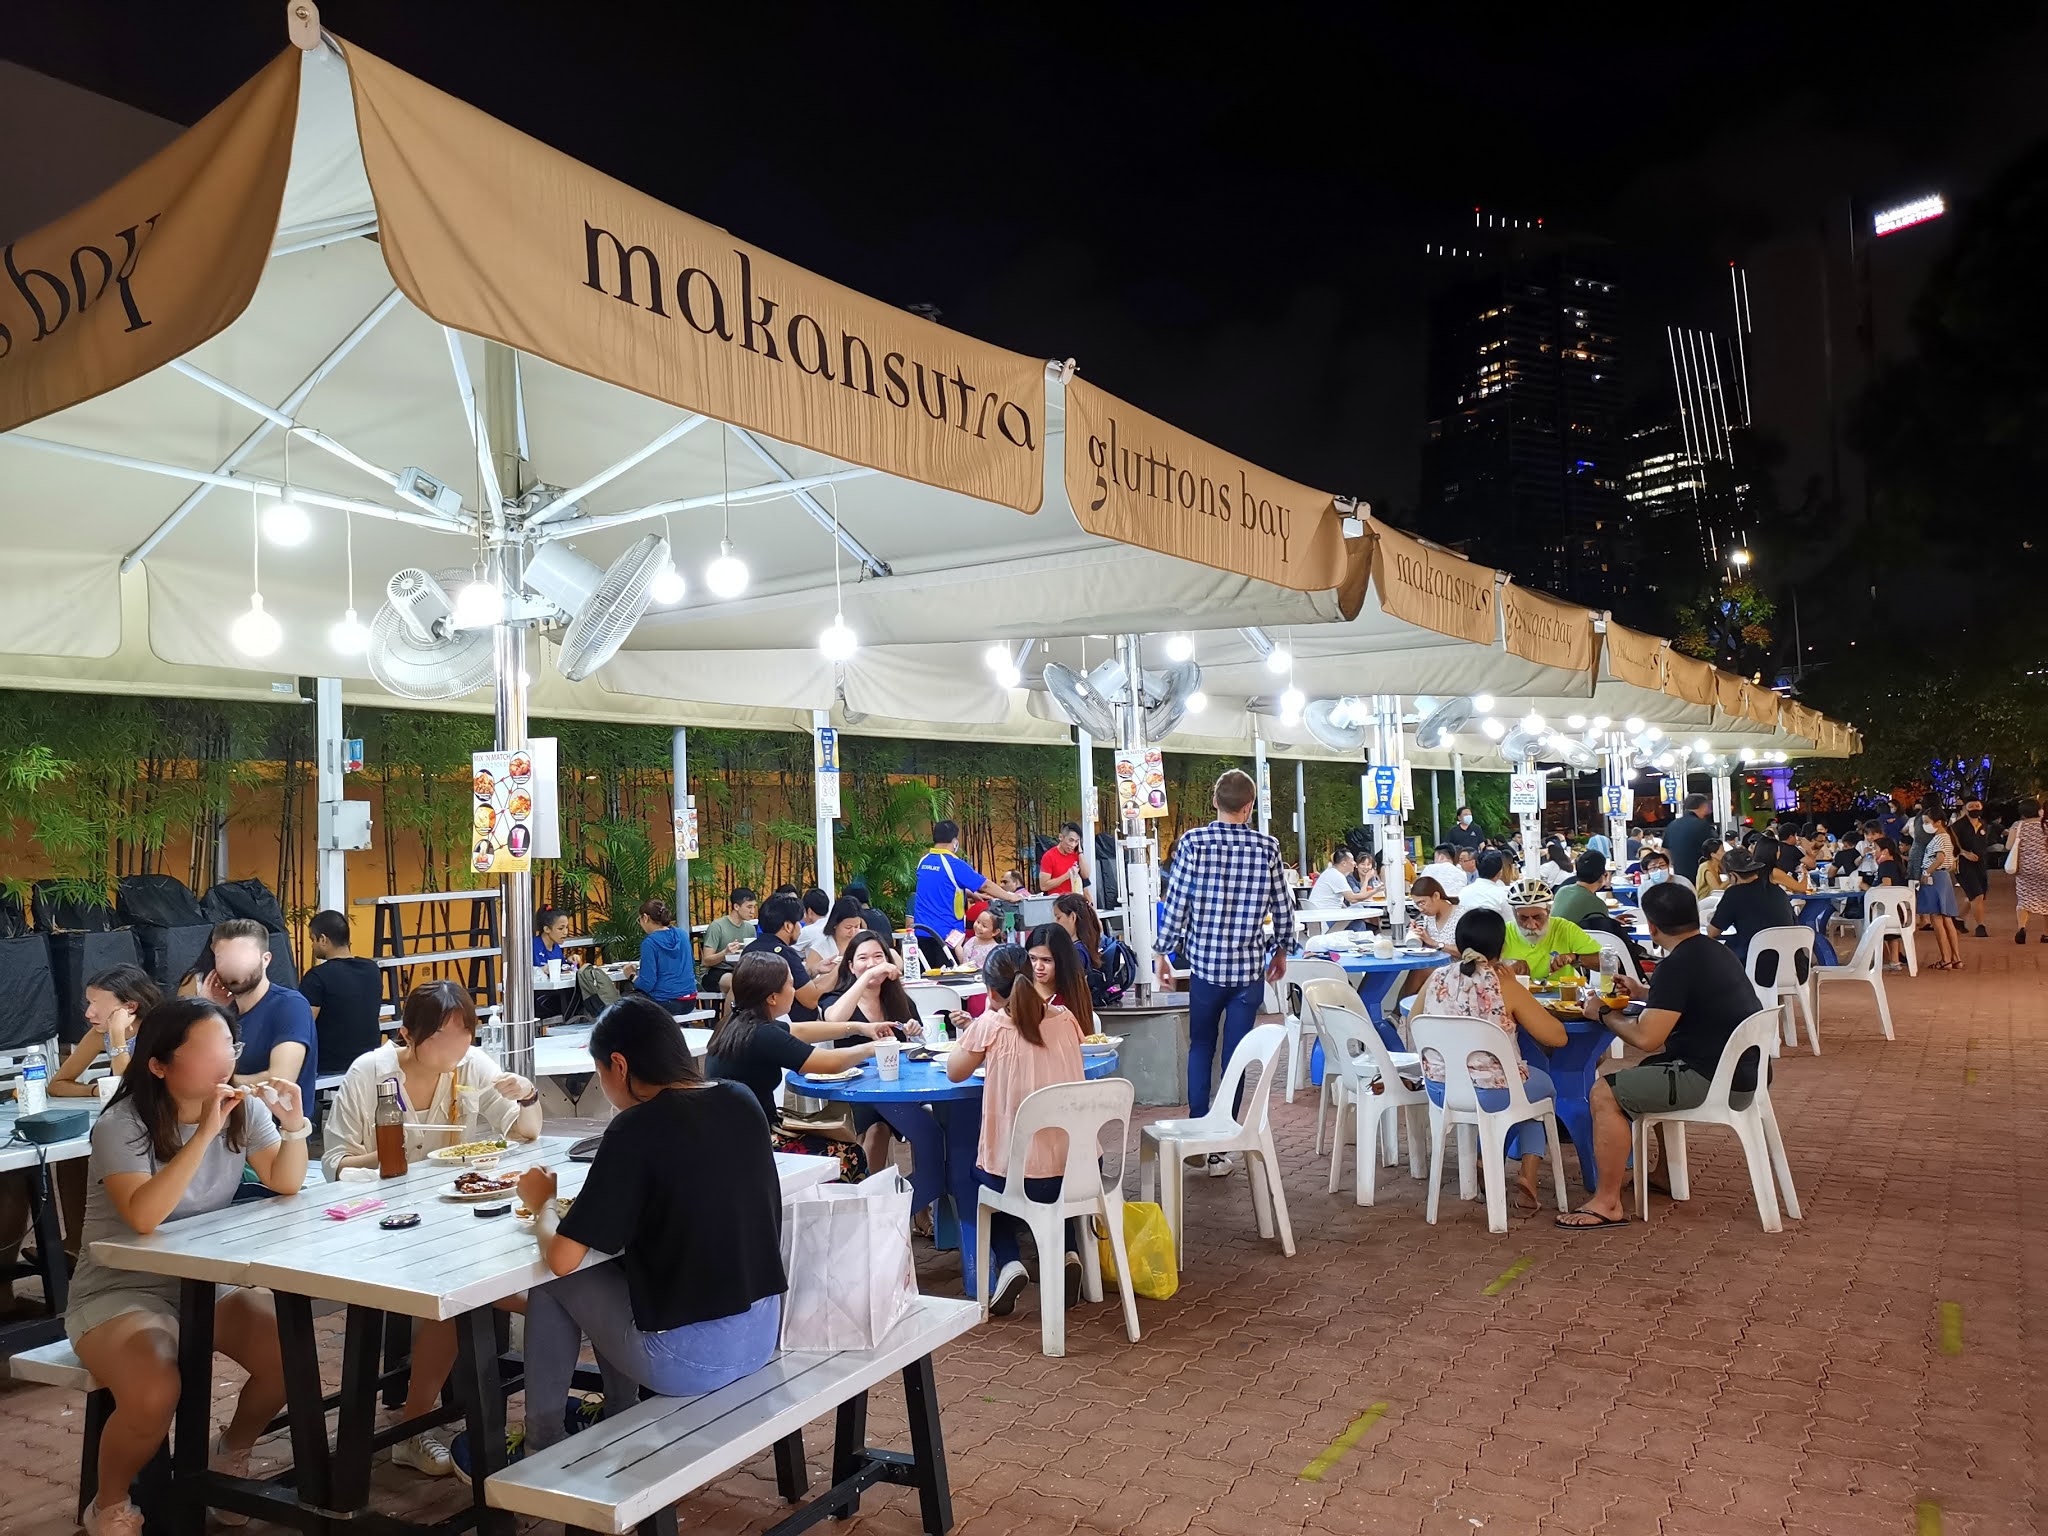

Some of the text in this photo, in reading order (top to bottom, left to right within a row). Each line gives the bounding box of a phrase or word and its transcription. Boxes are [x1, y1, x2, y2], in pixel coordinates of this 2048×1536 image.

[4, 212, 162, 342] bay
[582, 218, 1036, 451] makansutra
[1088, 418, 1292, 563] gluttons bay
[1552, 607, 1573, 658] bay
[491, 753, 511, 761] MATCH
